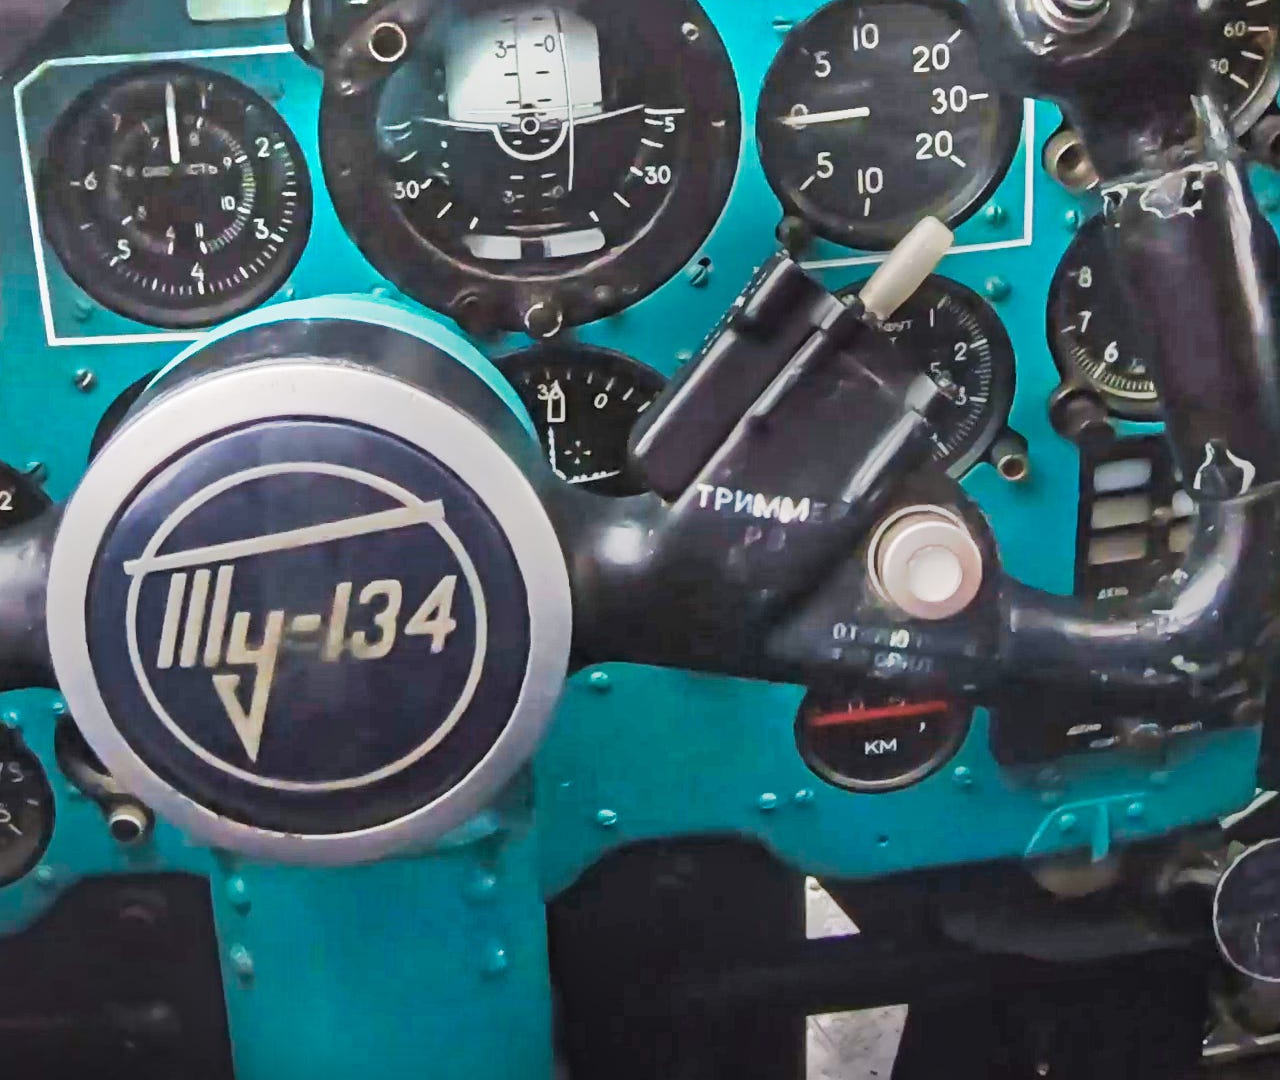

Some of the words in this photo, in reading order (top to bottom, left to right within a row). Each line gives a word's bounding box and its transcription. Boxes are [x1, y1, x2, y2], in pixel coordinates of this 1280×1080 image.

[852, 23, 879, 49] 10
[1223, 21, 1247, 37] 60
[814, 50, 832, 78] 5
[913, 43, 950, 73] 20
[931, 85, 967, 115] 30
[255, 136, 271, 158] 2
[915, 130, 954, 160] 20
[644, 165, 672, 186] 30
[817, 151, 834, 179] 5
[84, 171, 98, 191] 6
[857, 167, 883, 193] 10
[221, 195, 236, 211] 10
[254, 218, 270, 239] 3
[117, 239, 131, 260] 5
[191, 262, 205, 282] 4
[1078, 266, 1093, 288] 8
[1078, 310, 1093, 333] 7
[954, 341, 969, 361] 2
[1104, 341, 1120, 363] 6
[593, 392, 609, 409] 0
